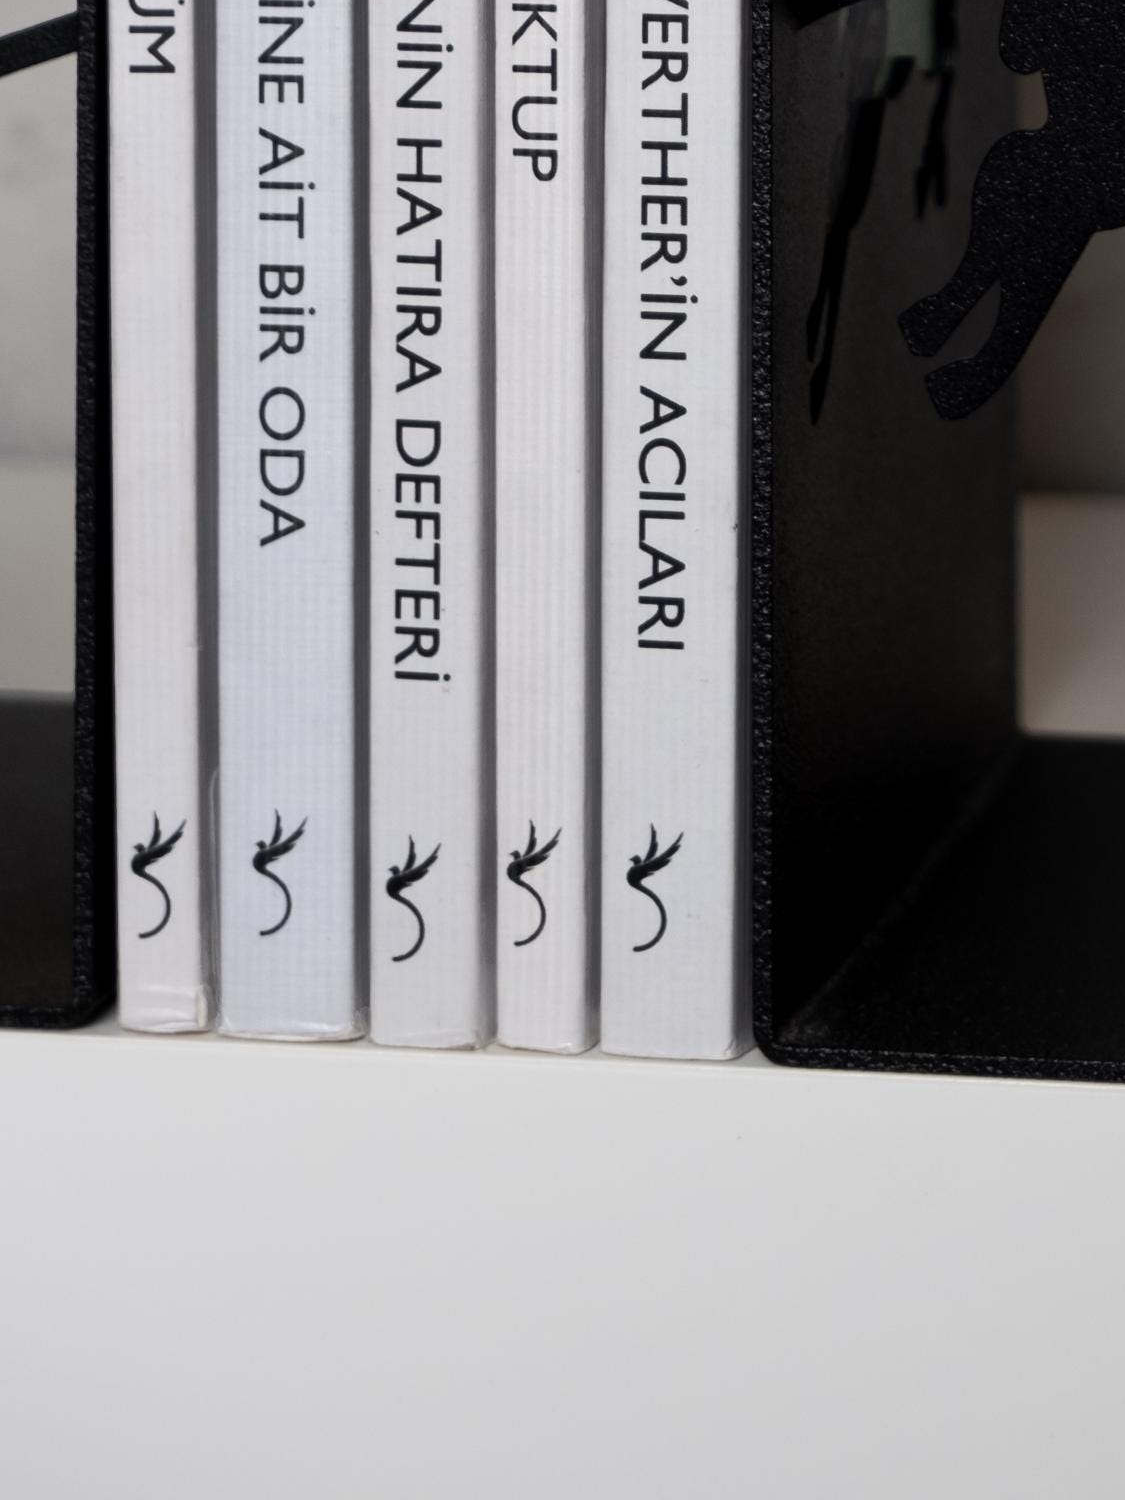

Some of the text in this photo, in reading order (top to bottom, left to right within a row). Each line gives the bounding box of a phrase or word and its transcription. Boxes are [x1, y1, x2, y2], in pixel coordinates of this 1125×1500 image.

[258, 127, 316, 239] AİT
[395, 138, 443, 393] HATIRA
[259, 264, 316, 362] BİR
[259, 386, 306, 547] ODA
[394, 418, 451, 682] DEFTERİ
[637, 385, 688, 650] ACILARI
